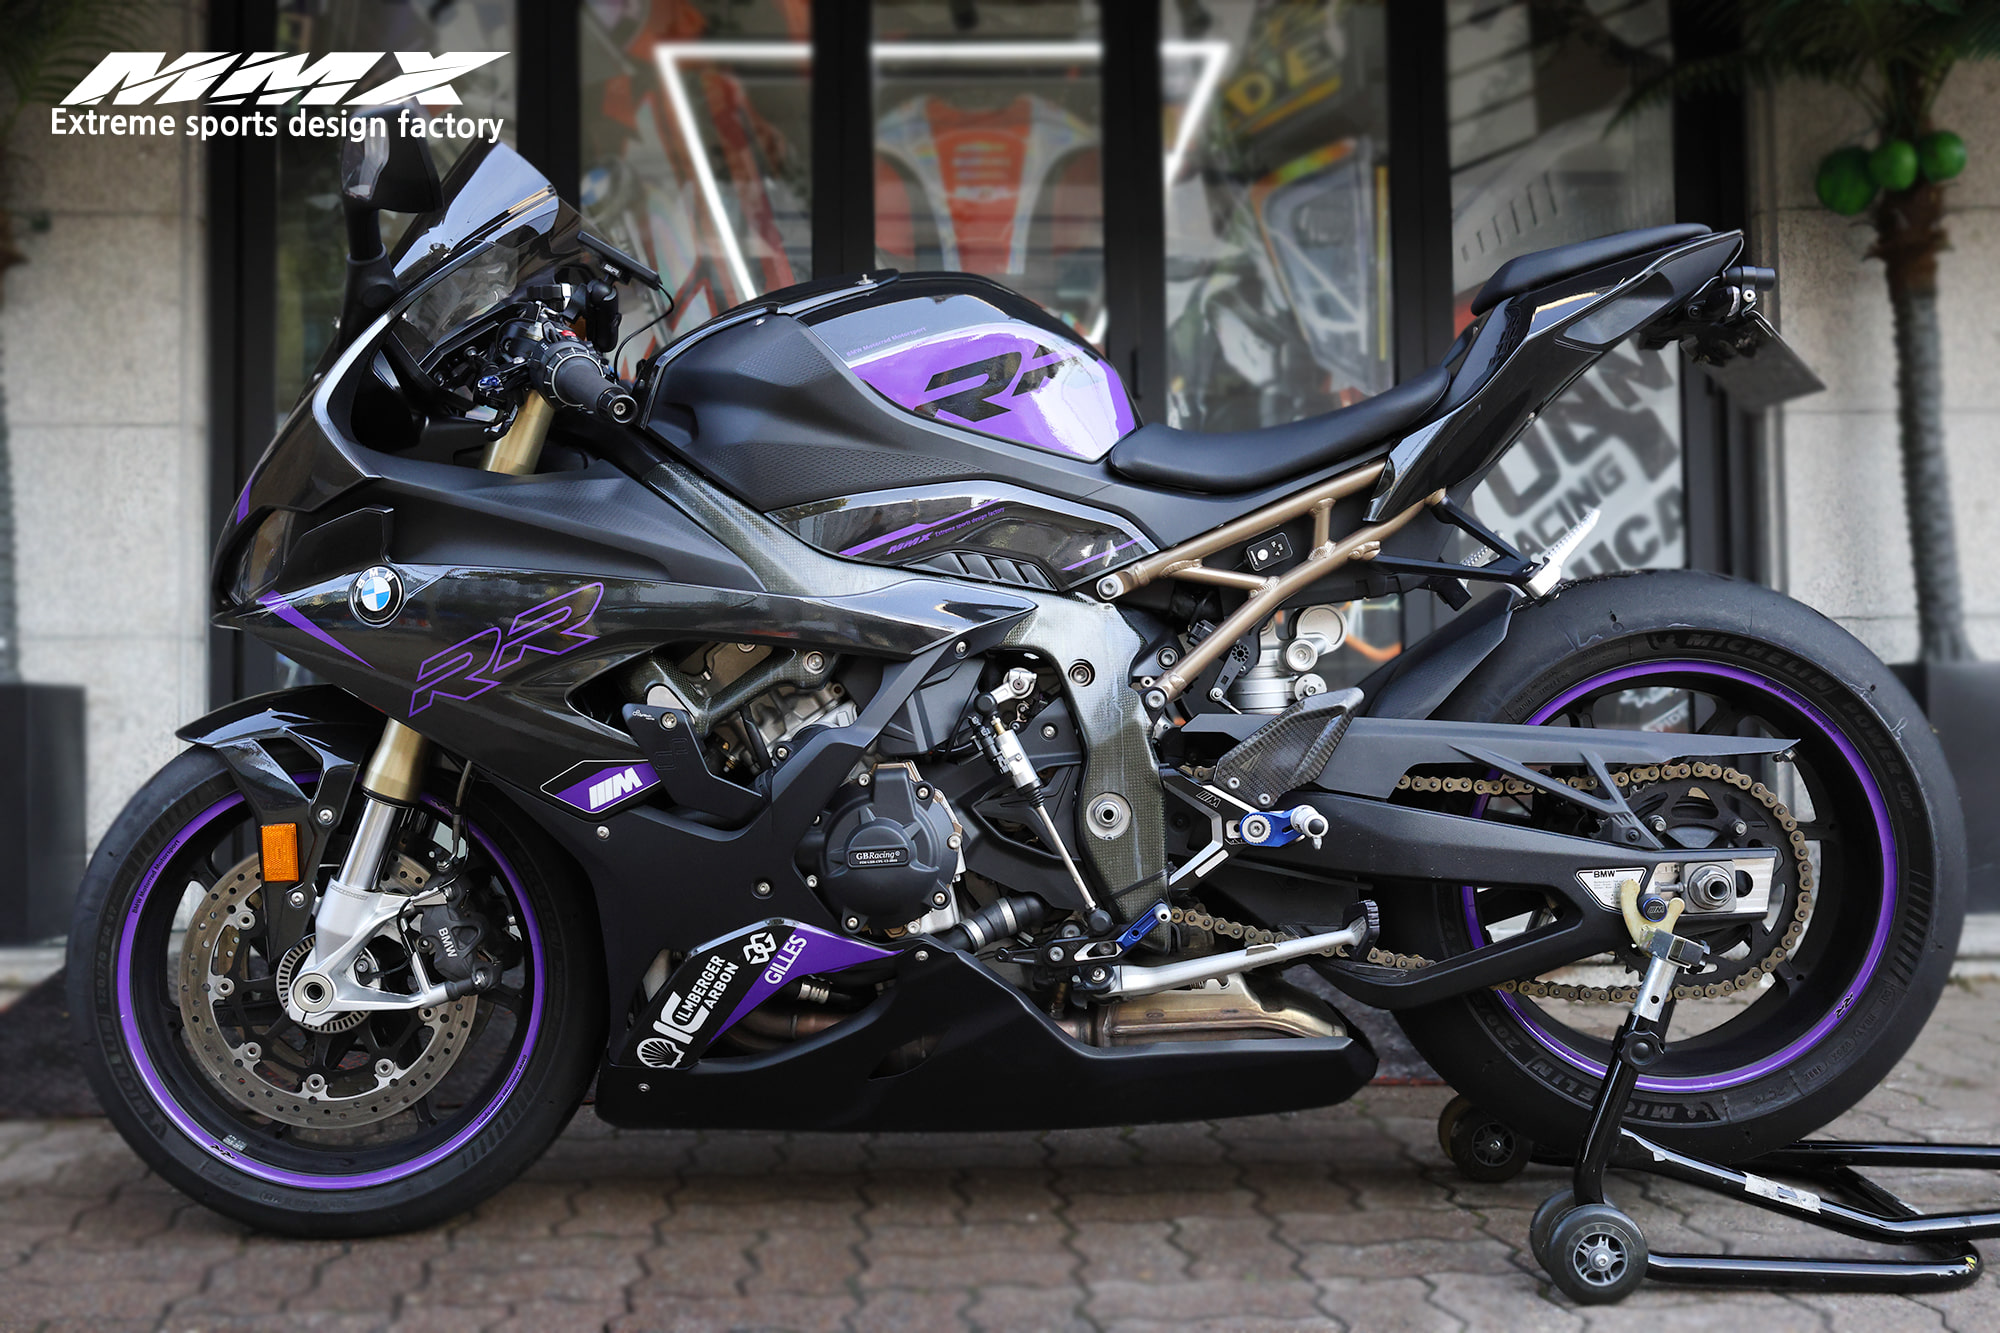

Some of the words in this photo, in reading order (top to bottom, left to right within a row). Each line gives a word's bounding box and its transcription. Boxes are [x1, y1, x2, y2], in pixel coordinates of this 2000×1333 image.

[891, 326, 927, 341] Motorsport
[886, 531, 934, 556] MMX
[934, 525, 956, 538] Extreme
[987, 506, 1005, 518] factory
[356, 568, 395, 589] BMW
[408, 582, 604, 718] RR
[1686, 630, 1834, 695] MICHELIN
[132, 897, 144, 914] BMW
[139, 870, 157, 898] Motorrad
[154, 840, 180, 870] Motorsport
[1593, 870, 1616, 878] BMW
[438, 927, 458, 958] BMW
[764, 934, 808, 984] GILLES
[675, 955, 725, 1022] ILMBERGER
[703, 962, 739, 1009] ARBON
